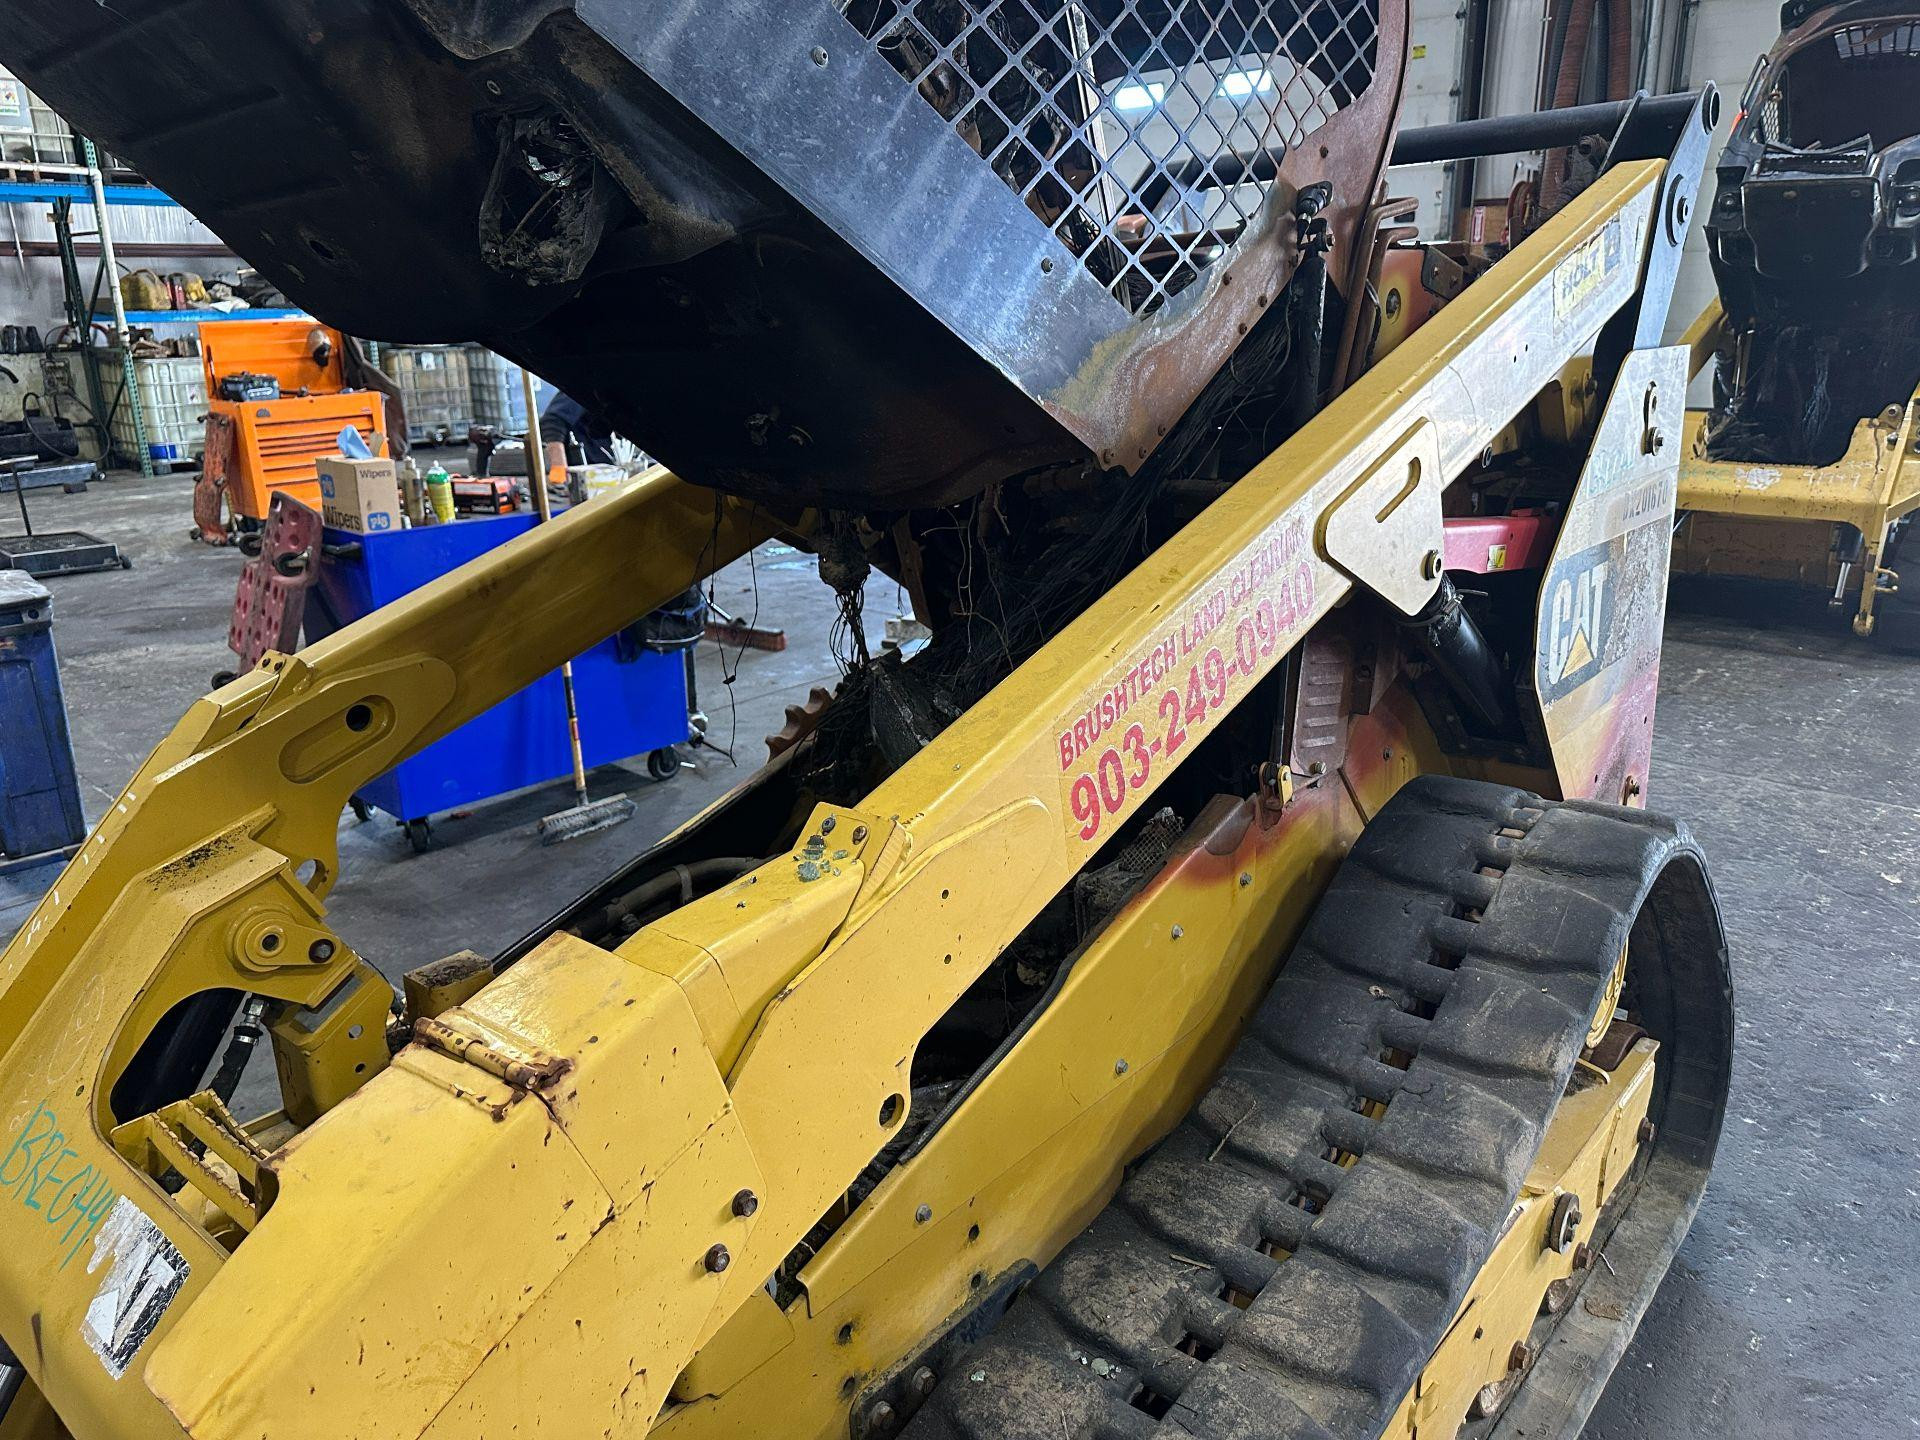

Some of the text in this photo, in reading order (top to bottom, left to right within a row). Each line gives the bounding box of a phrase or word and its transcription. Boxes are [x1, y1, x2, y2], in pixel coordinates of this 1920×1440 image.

[323, 504, 361, 531] Wipers
[359, 469, 392, 481] Wipers
[1058, 634, 1178, 772] BRUSHTECH
[1181, 589, 1226, 656] LAND
[1548, 561, 1608, 685] CAT
[1070, 561, 1314, 841] 903-249-0940
